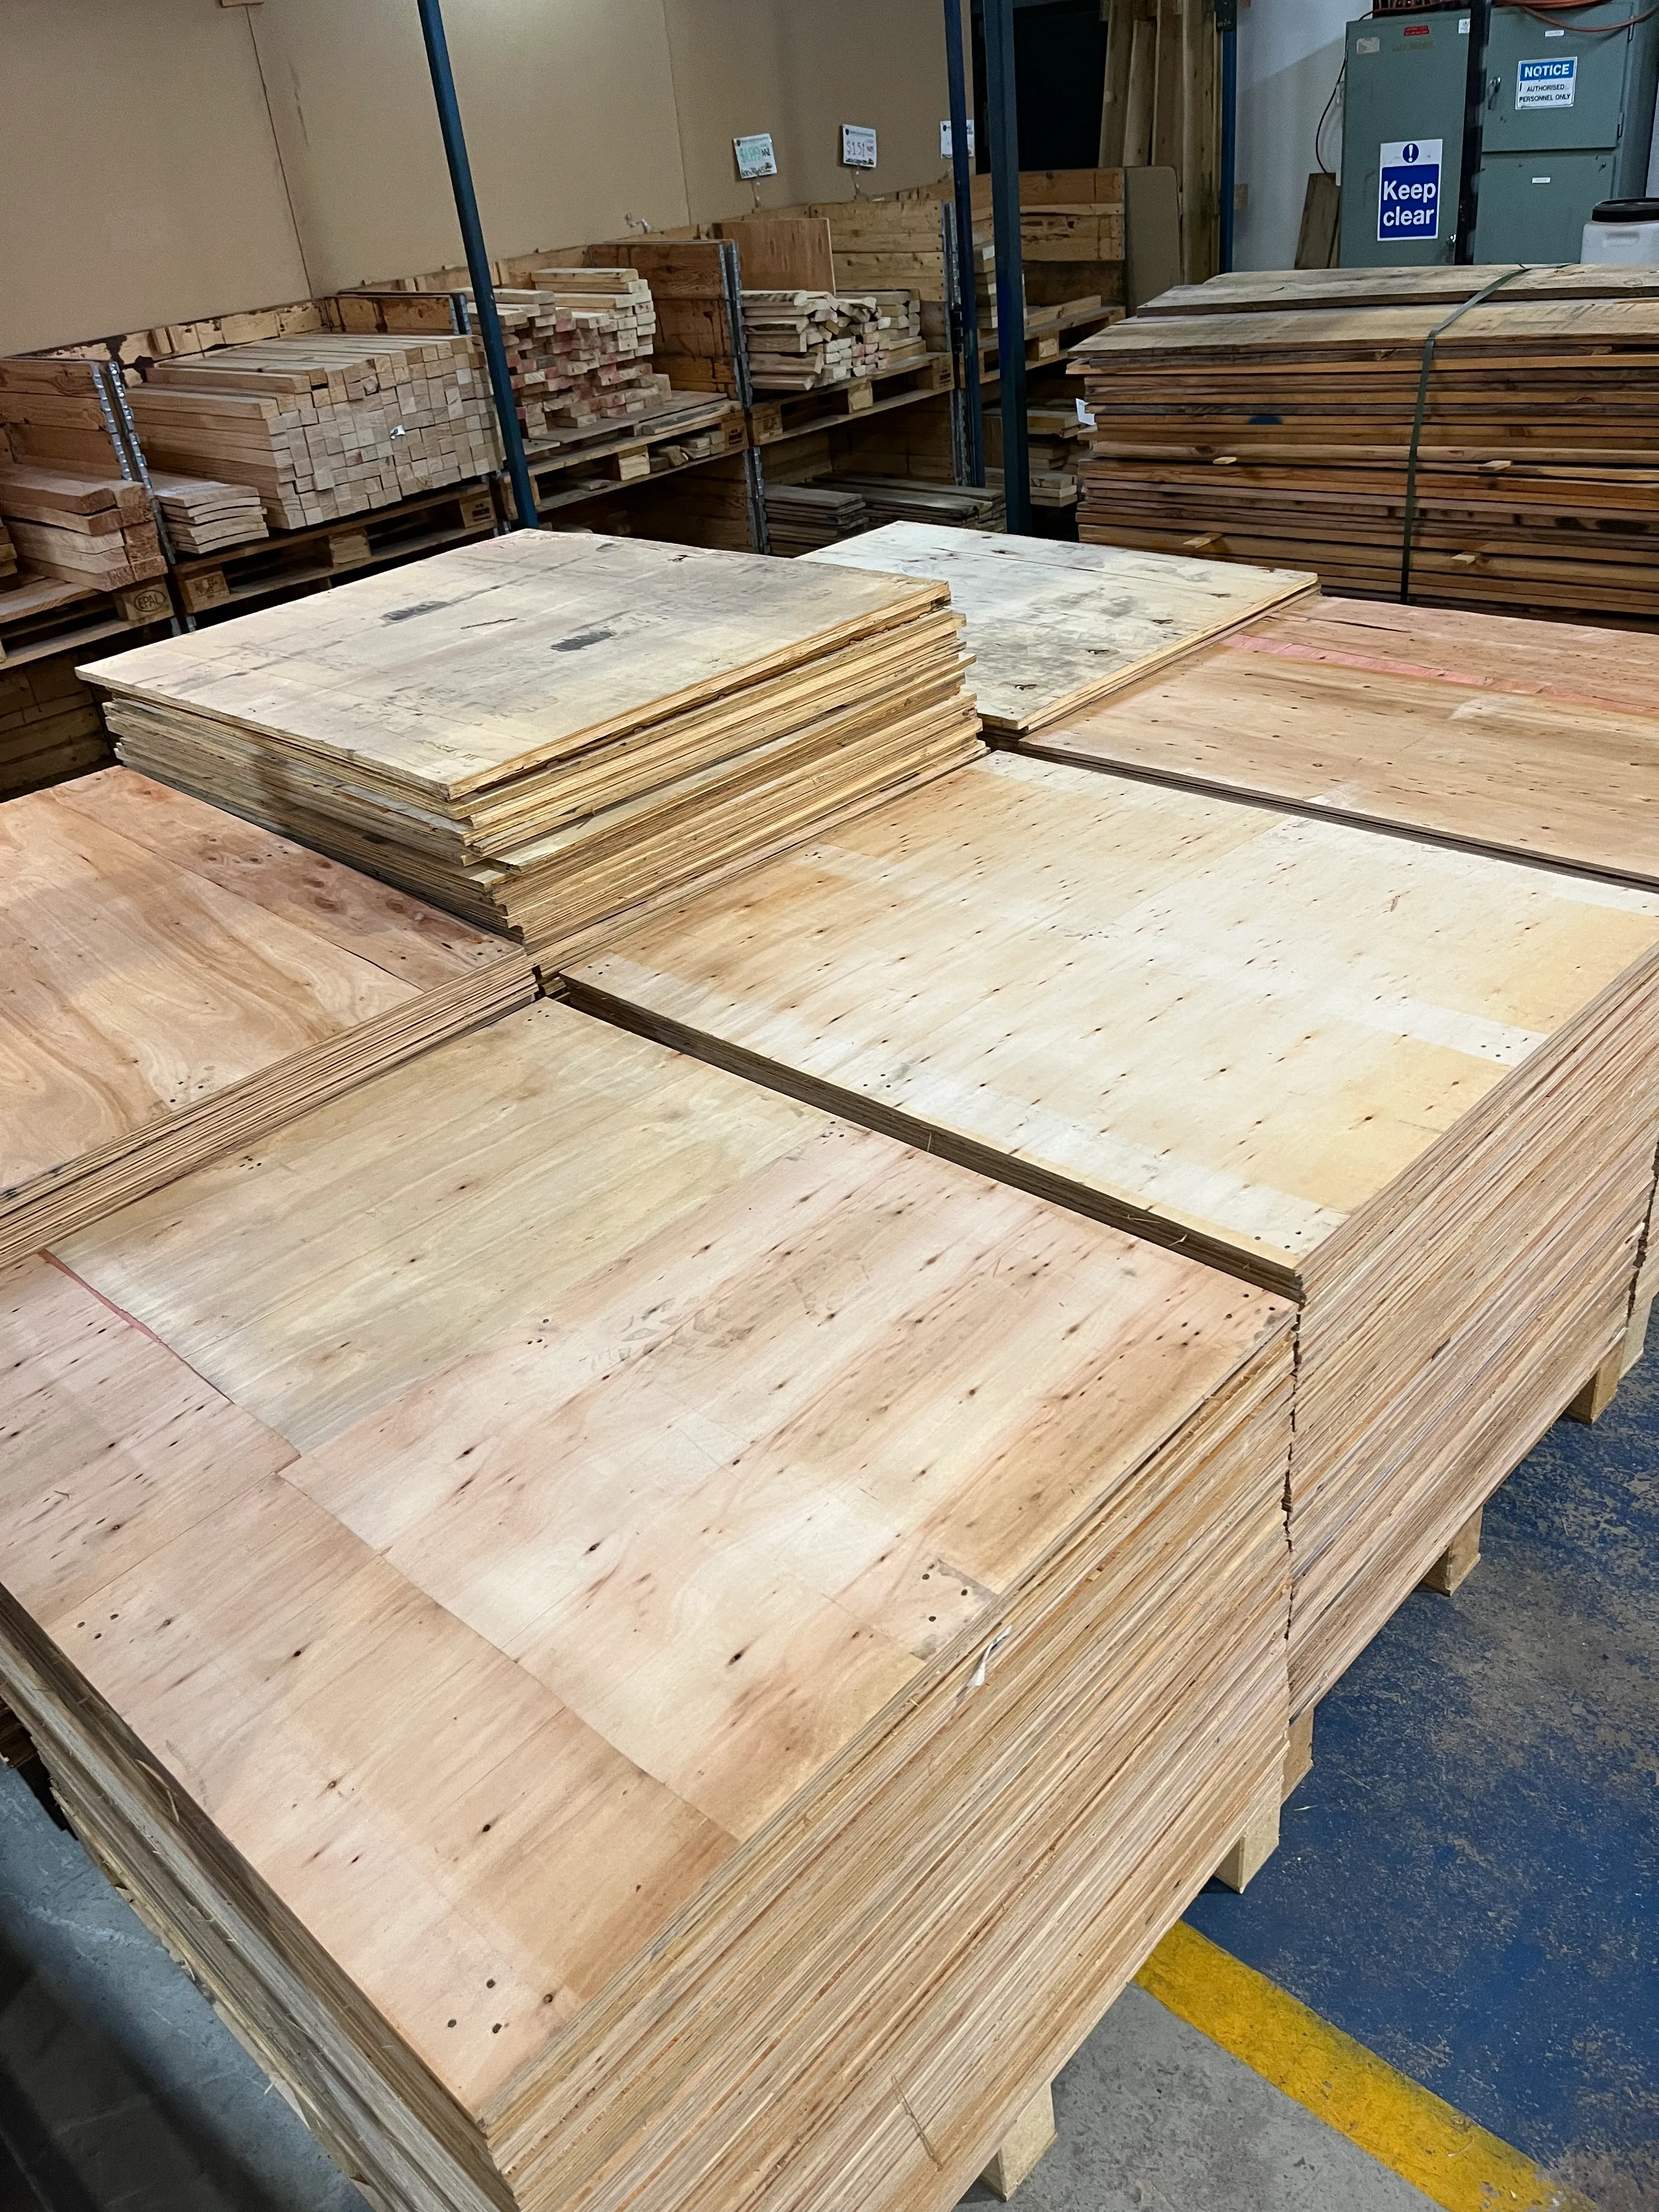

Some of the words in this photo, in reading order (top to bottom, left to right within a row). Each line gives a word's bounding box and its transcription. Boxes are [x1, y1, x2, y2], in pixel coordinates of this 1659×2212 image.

[1524, 64, 1570, 77] NOTICE
[1527, 84, 1565, 92] AUTHORISED
[1383, 180, 1436, 203] Keep
[1383, 206, 1435, 227] clear
[138, 594, 161, 609] EPAL
